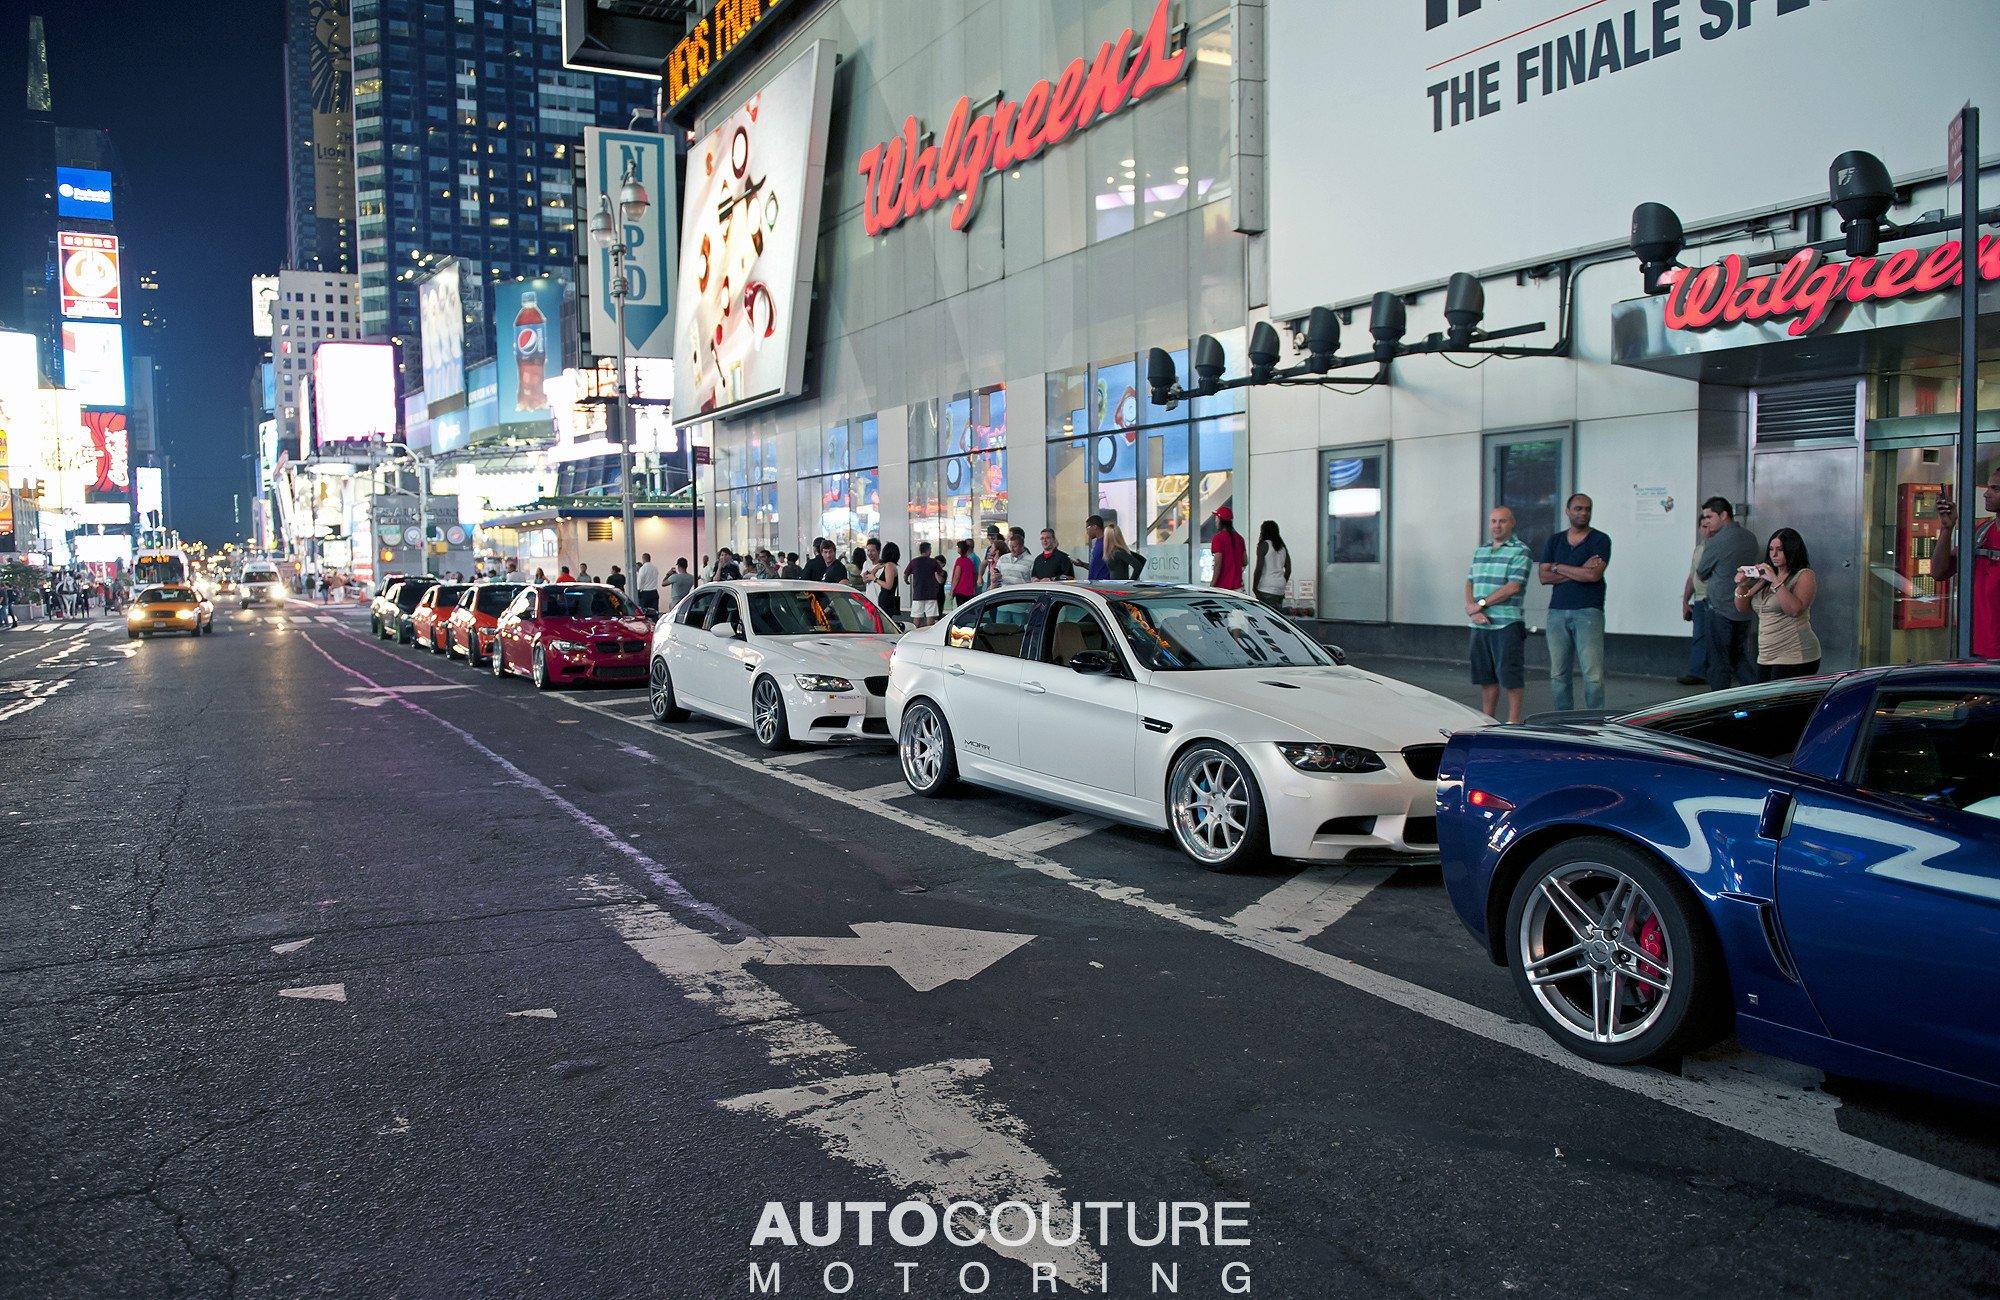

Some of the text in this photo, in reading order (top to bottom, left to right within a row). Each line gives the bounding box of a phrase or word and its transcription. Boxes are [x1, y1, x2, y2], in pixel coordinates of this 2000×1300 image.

[668, 18, 709, 107] NEWS
[858, 0, 1186, 237] Walgreens
[1426, 60, 1500, 133] THE
[1516, 0, 1682, 104] FINALE
[620, 144, 647, 301] NPD
